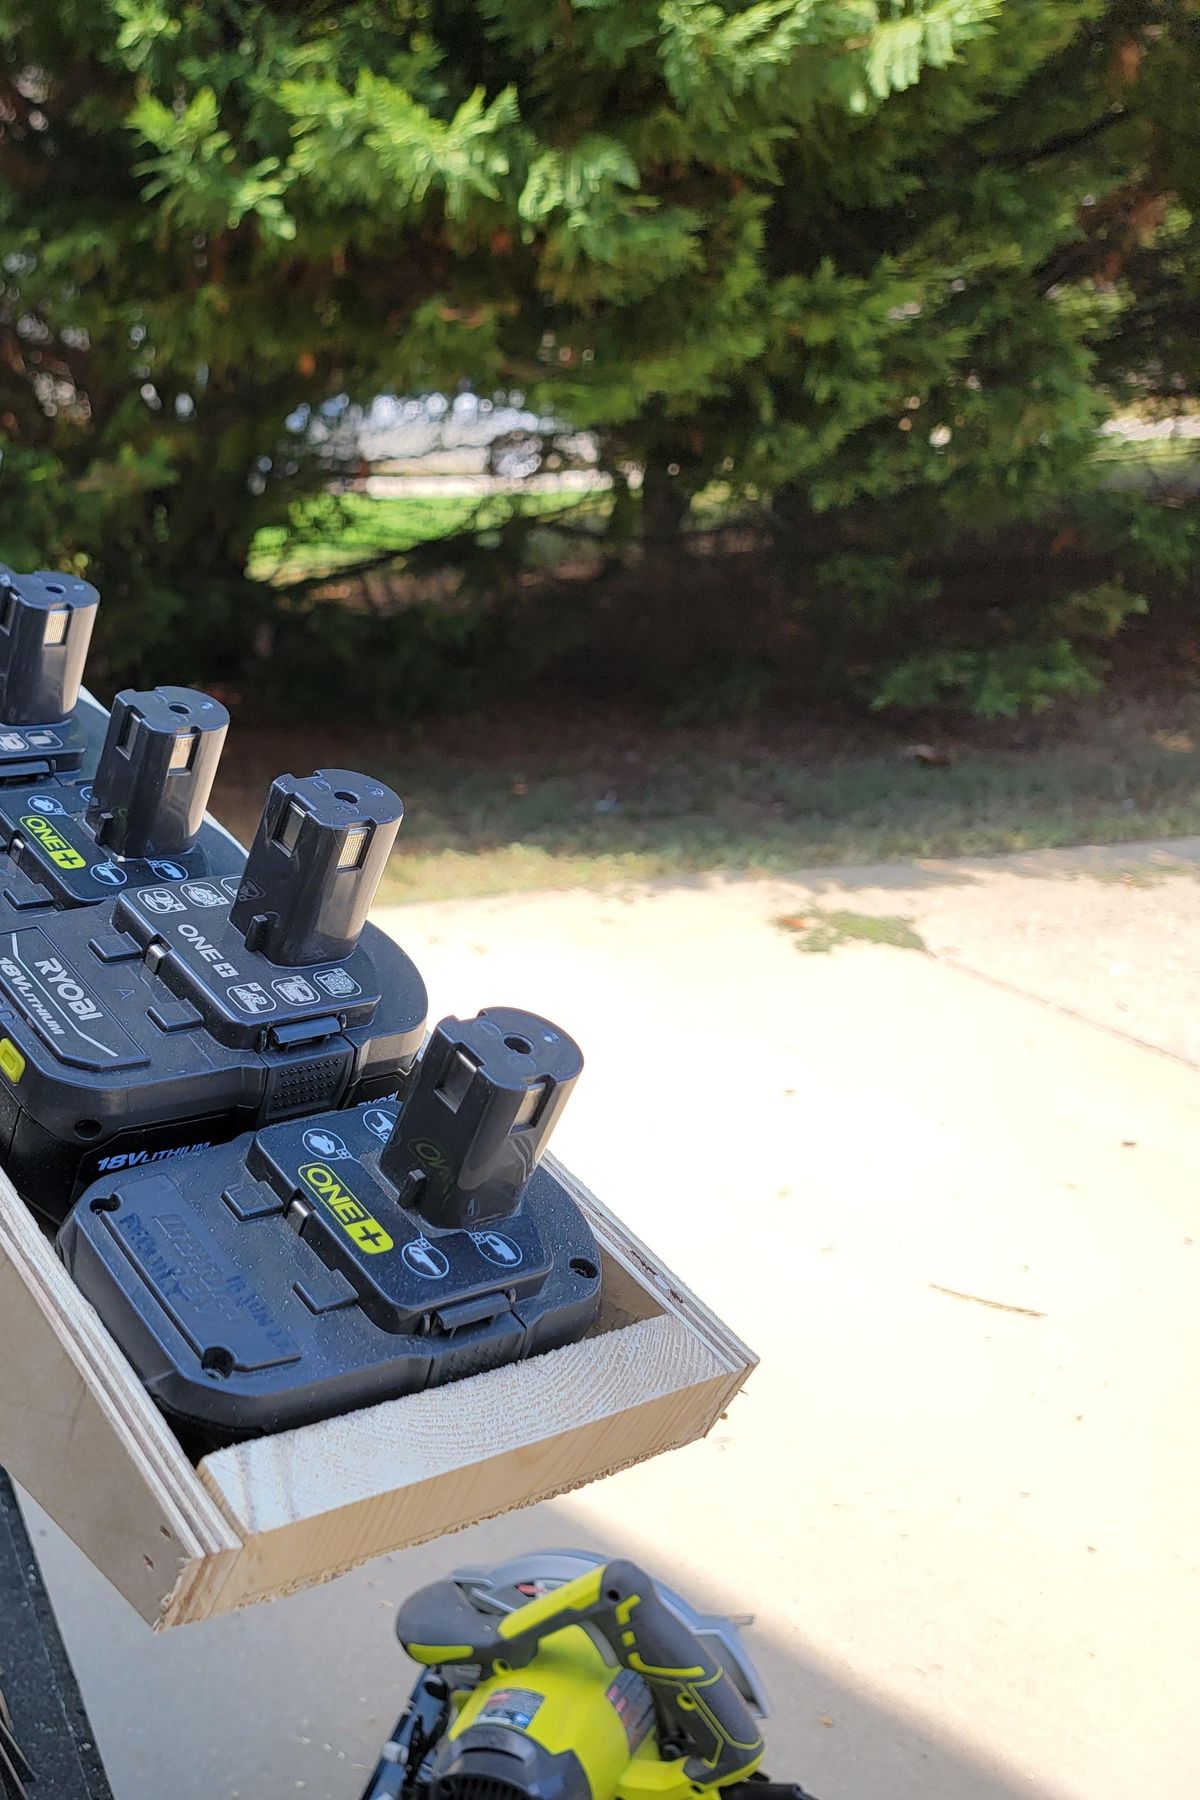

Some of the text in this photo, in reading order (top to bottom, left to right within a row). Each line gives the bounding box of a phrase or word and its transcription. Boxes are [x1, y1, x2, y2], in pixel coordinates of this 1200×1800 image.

[24, 816, 82, 867] ONE+
[178, 924, 239, 978] ONE+
[35, 958, 103, 1021] RYOBI
[303, 1165, 390, 1251] ONE+
